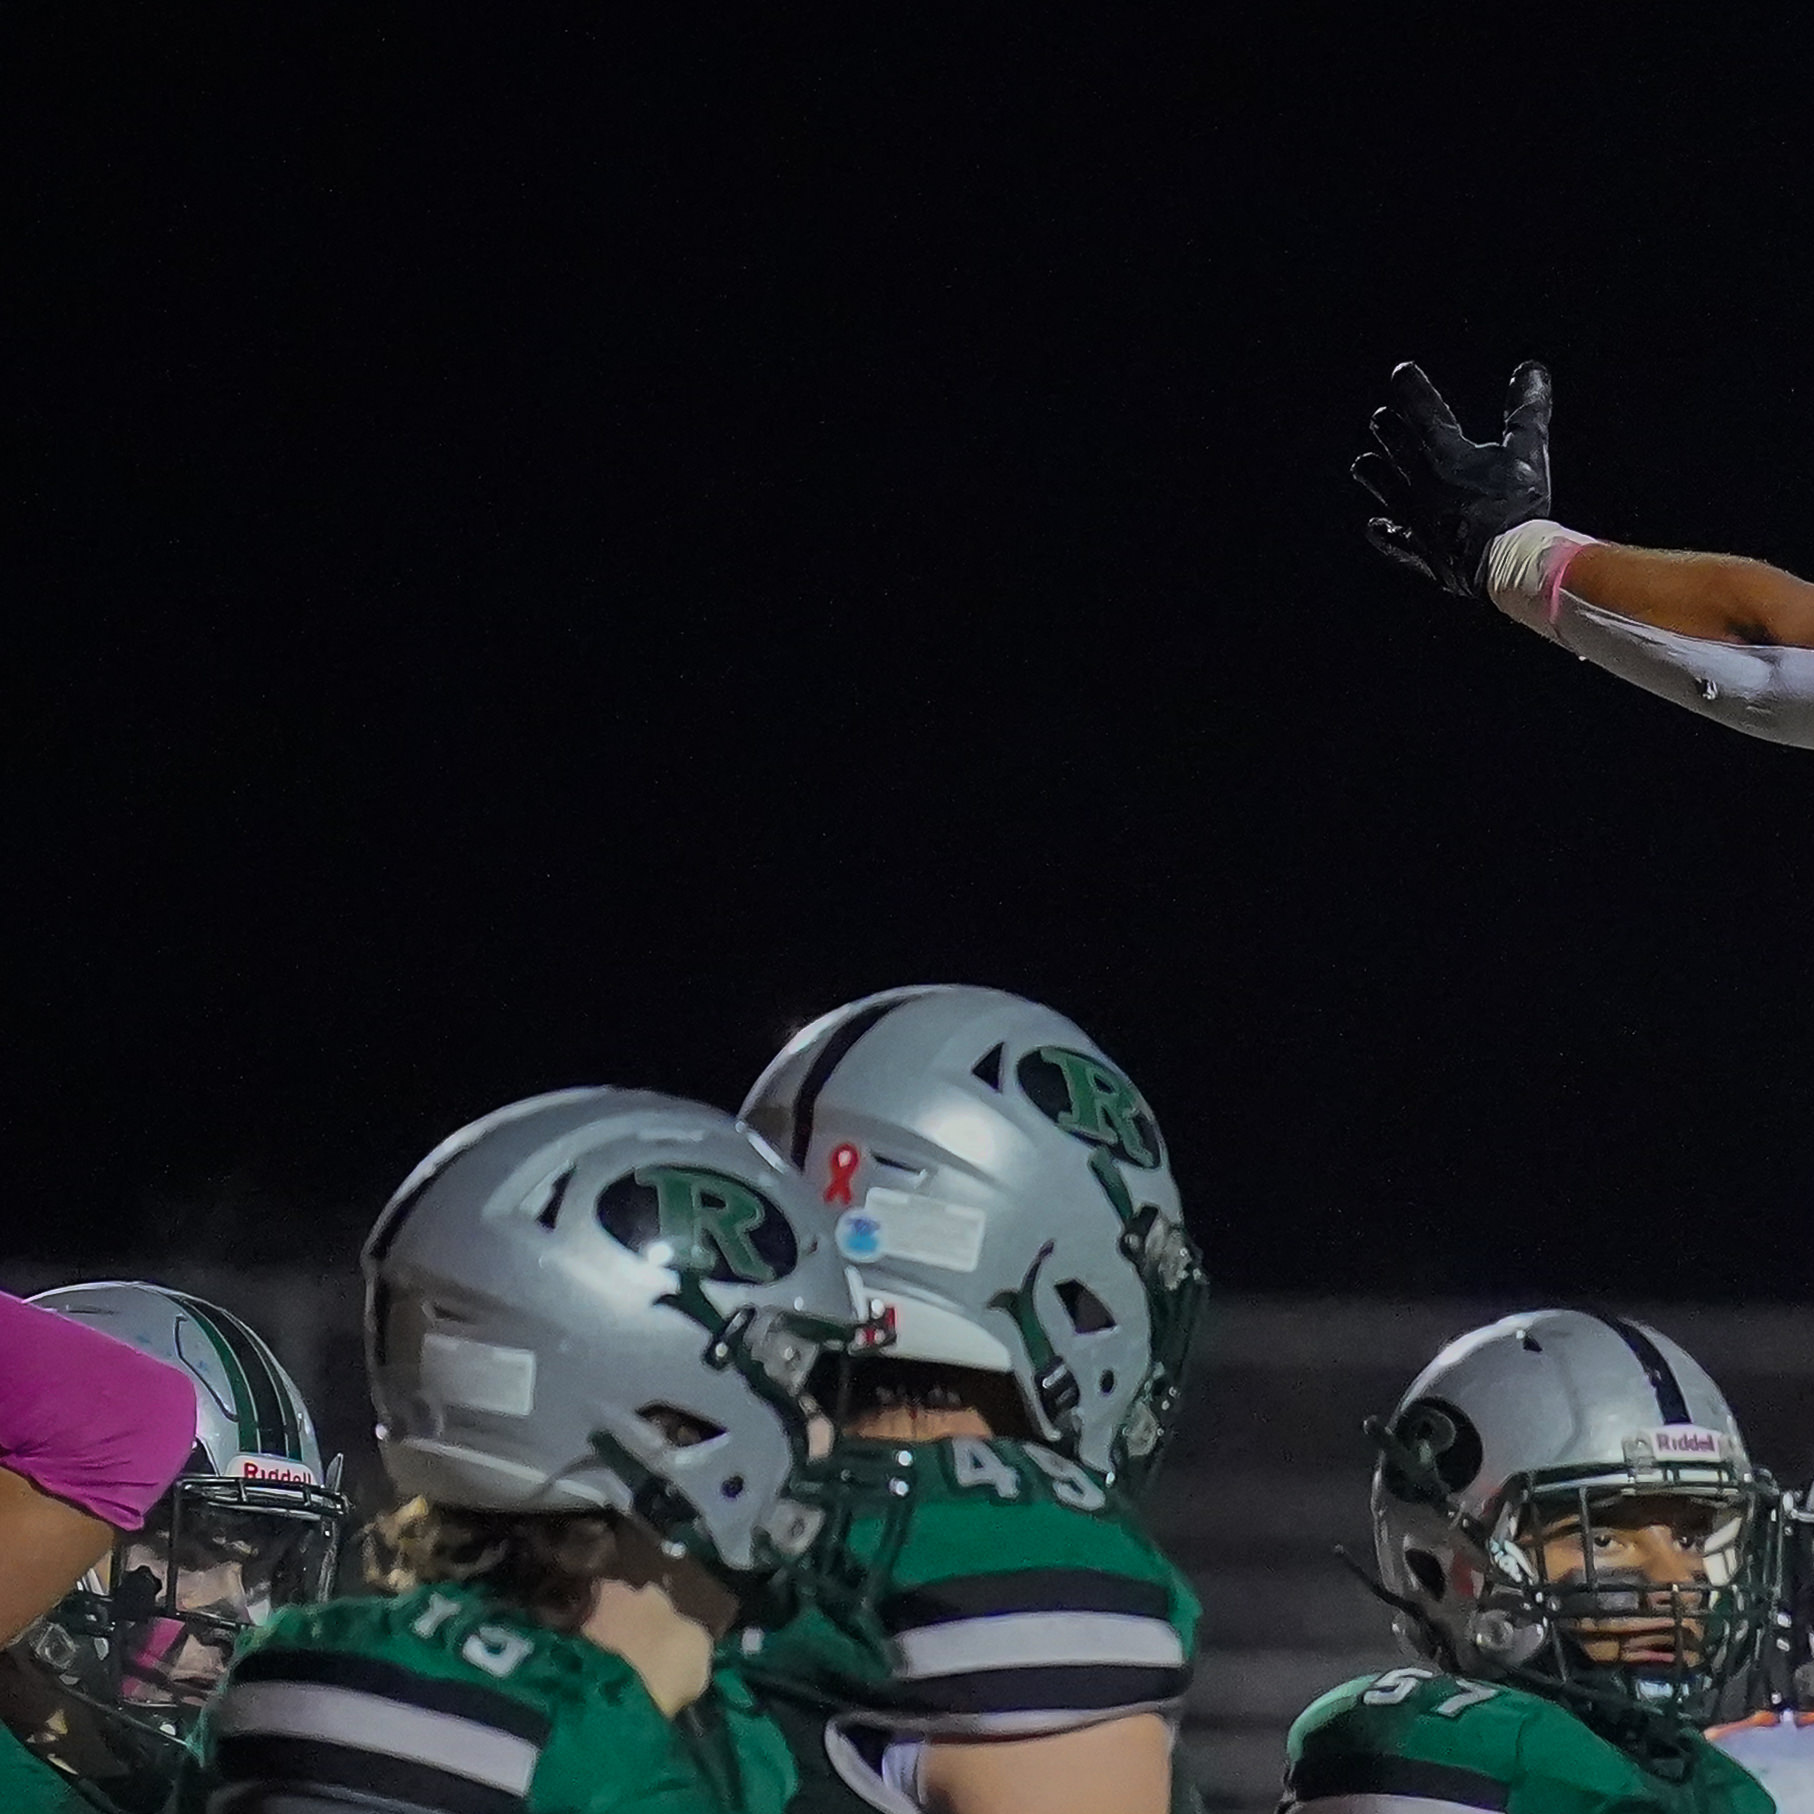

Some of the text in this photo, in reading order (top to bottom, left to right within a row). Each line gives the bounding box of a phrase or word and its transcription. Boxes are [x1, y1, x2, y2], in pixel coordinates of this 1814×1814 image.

[1040, 1046, 1156, 1168] R
[633, 1164, 776, 1282] R
[1362, 1666, 1501, 1718] 57
